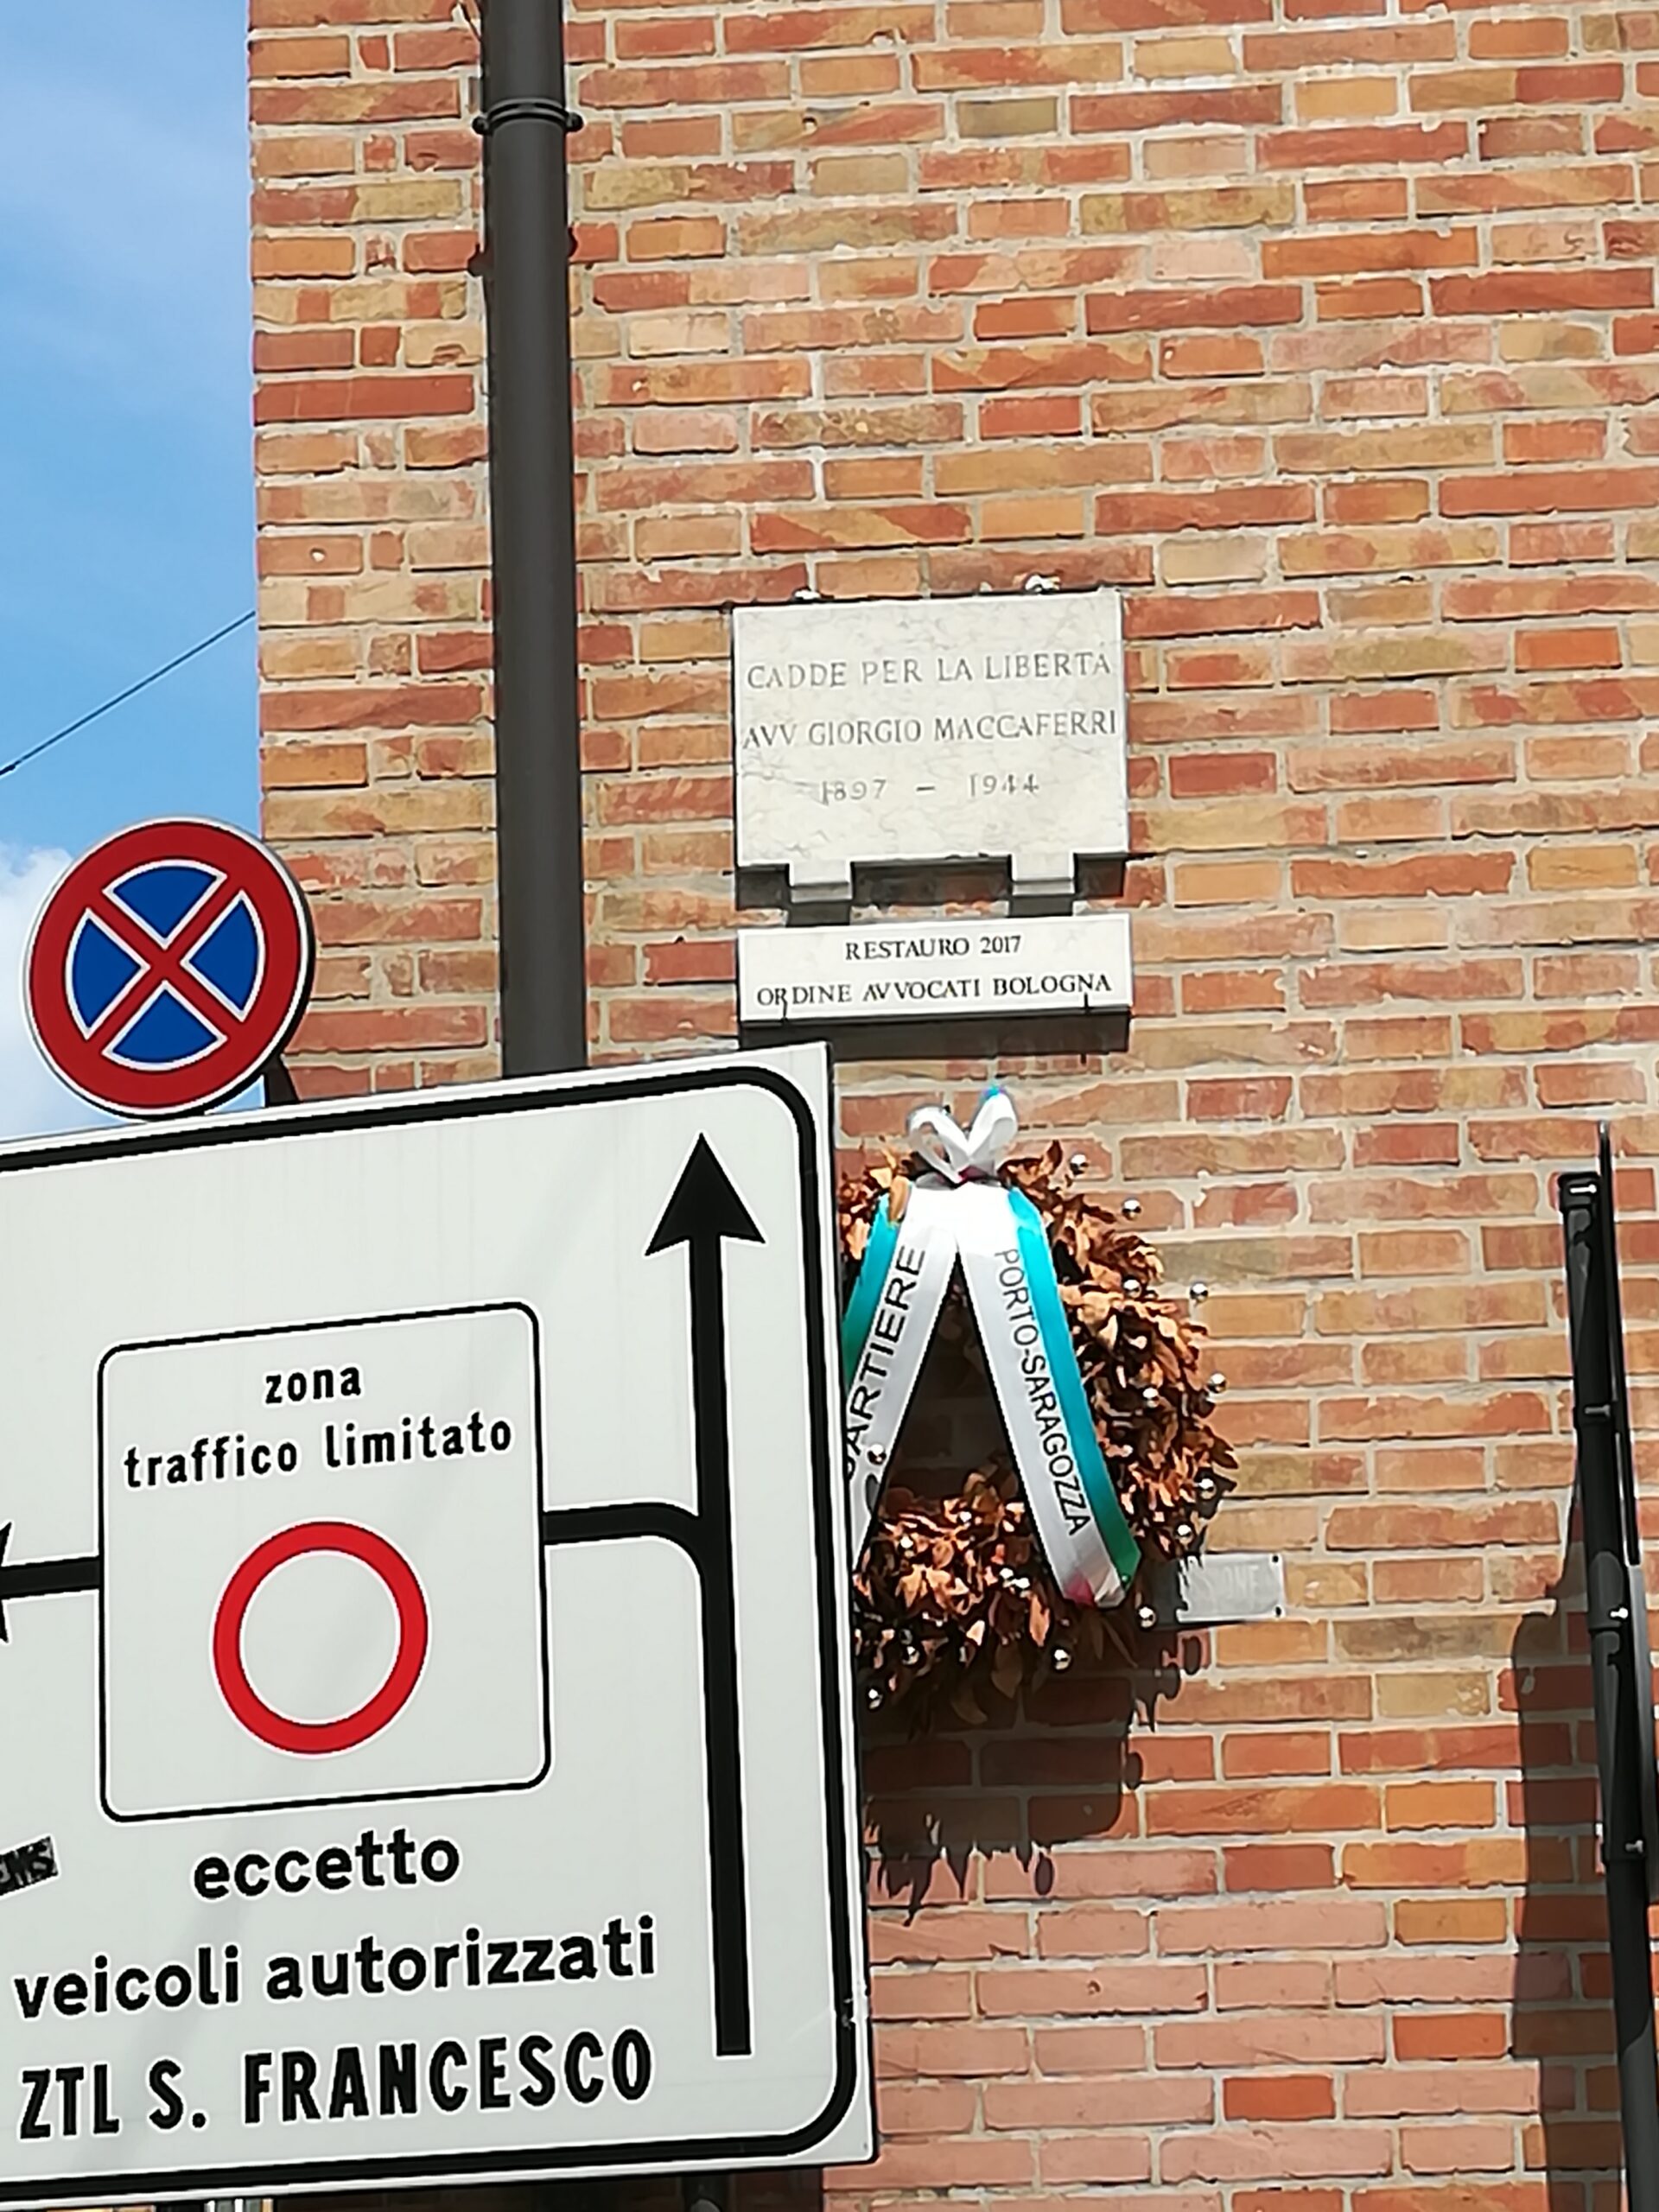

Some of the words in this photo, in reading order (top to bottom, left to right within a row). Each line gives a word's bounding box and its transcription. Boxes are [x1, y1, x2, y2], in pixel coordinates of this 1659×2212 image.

[747, 662, 847, 689] CADDE
[862, 659, 922, 685] PER
[938, 658, 972, 682] LA
[743, 724, 797, 749] AVV
[809, 720, 921, 746] GIORGIO
[934, 710, 1116, 741] MACCAFERRI
[823, 779, 887, 804] 1897
[969, 773, 1039, 798] 1944
[846, 938, 969, 960] RESTAURO
[981, 935, 1021, 954] 2017
[758, 983, 850, 1007] ORDINE
[863, 979, 980, 1001] AVVOCATI
[994, 974, 1111, 996] BOLOGNA
[266, 1367, 360, 1404] zona
[995, 1249, 1092, 1535] PORTO-SARAGOZZA
[124, 1434, 297, 1488] traffico
[326, 1411, 512, 1468] limitato
[194, 1828, 460, 1899] eccetto
[15, 1944, 238, 2018] veicoli
[266, 1915, 654, 2000] autorizzati
[20, 2063, 119, 2139] ZTL
[149, 2059, 207, 2130] S.
[245, 2028, 652, 2124] FRANCESCO
